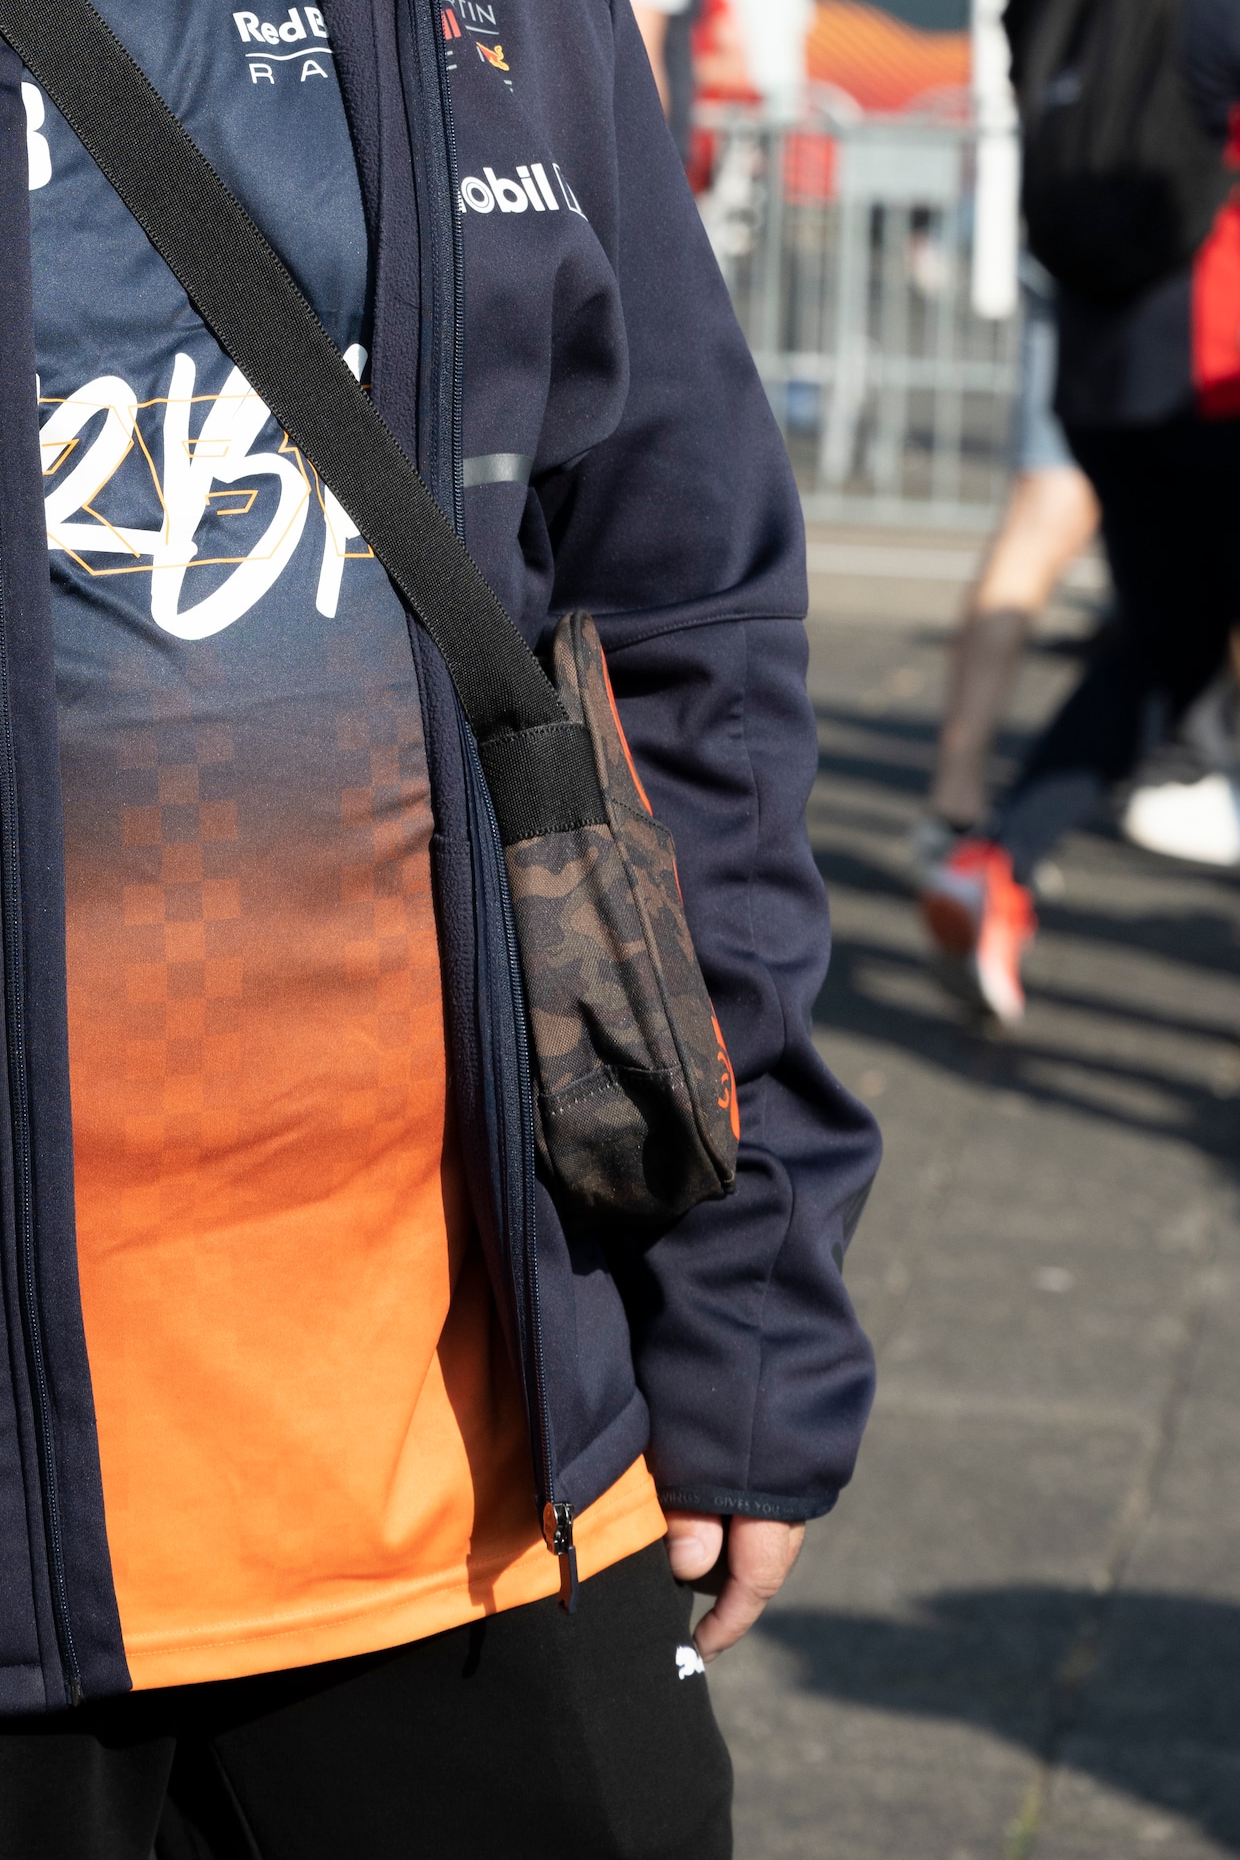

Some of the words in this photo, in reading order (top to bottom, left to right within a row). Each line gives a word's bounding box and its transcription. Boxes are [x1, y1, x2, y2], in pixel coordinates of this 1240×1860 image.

[232, 7, 303, 45] Red
[304, 6, 330, 39] B
[249, 59, 328, 85] RA
[459, 162, 560, 214] obil
